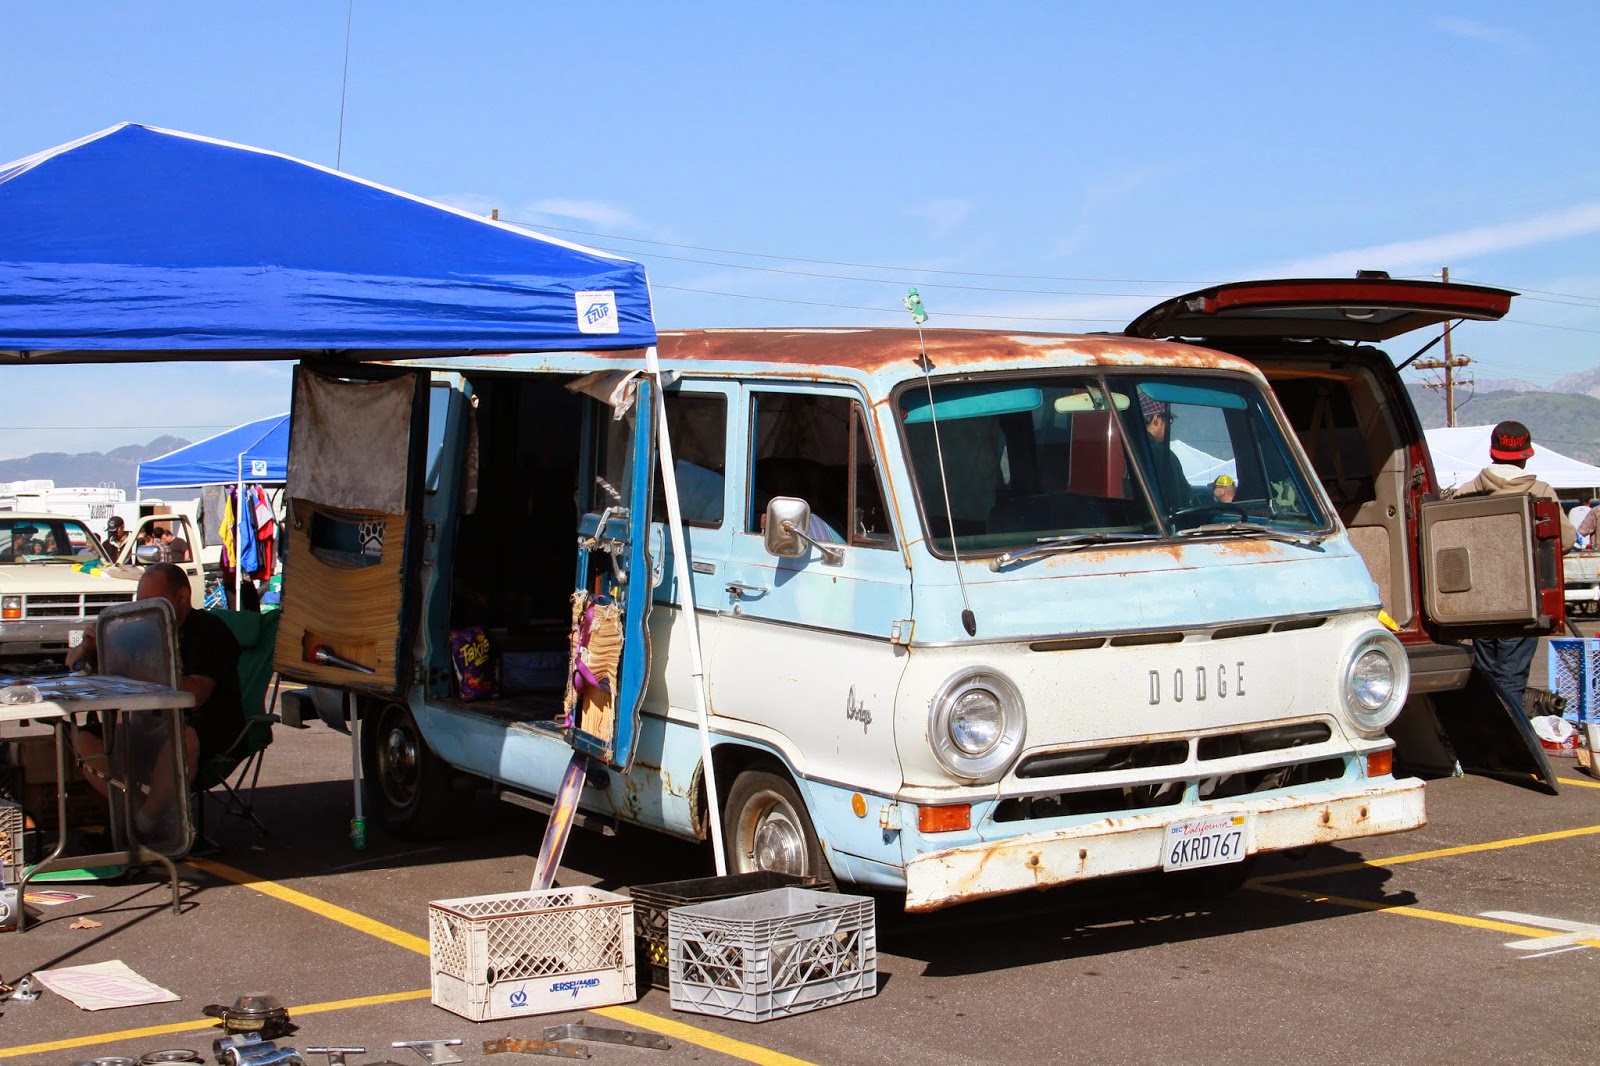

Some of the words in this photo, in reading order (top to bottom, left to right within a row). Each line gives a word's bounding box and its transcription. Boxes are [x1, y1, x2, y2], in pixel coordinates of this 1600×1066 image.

[460, 638, 490, 667] Takis
[1148, 661, 1246, 705] DODGE
[1171, 826, 1183, 834] DEC
[1183, 820, 1233, 836] California
[1170, 831, 1242, 865] 6KRD767
